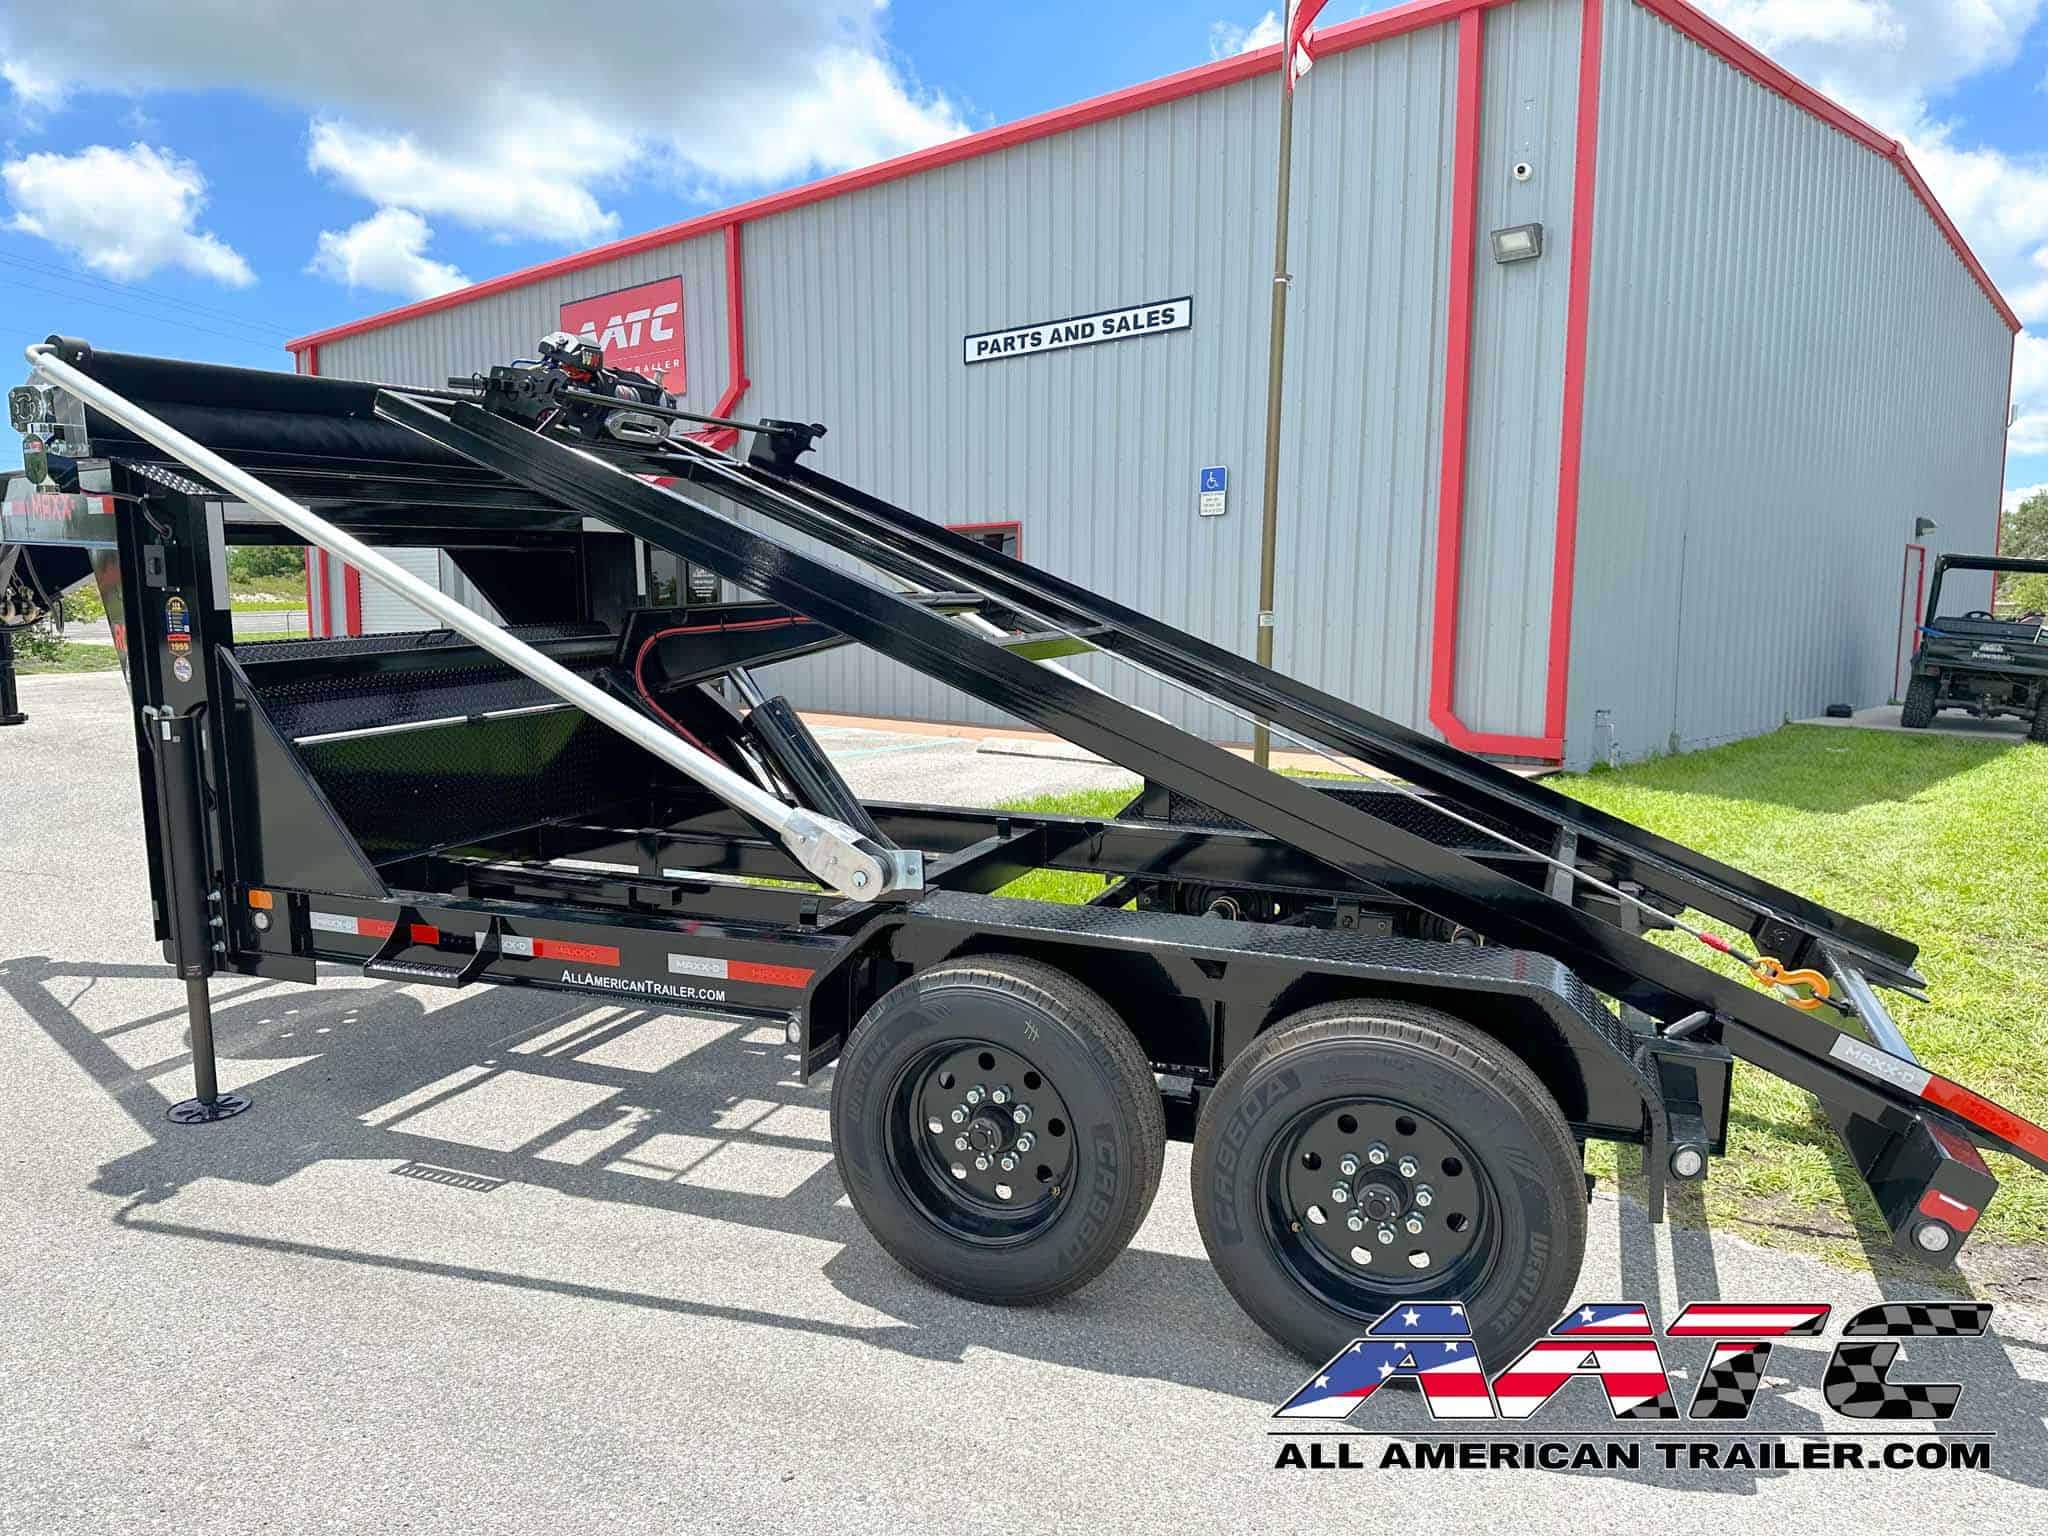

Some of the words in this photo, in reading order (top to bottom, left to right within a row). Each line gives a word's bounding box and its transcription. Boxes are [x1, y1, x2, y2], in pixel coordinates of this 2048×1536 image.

[580, 302, 678, 350] AATC
[977, 332, 1042, 356] PARTS
[1050, 323, 1095, 344] AND
[1102, 308, 1175, 335] SALES
